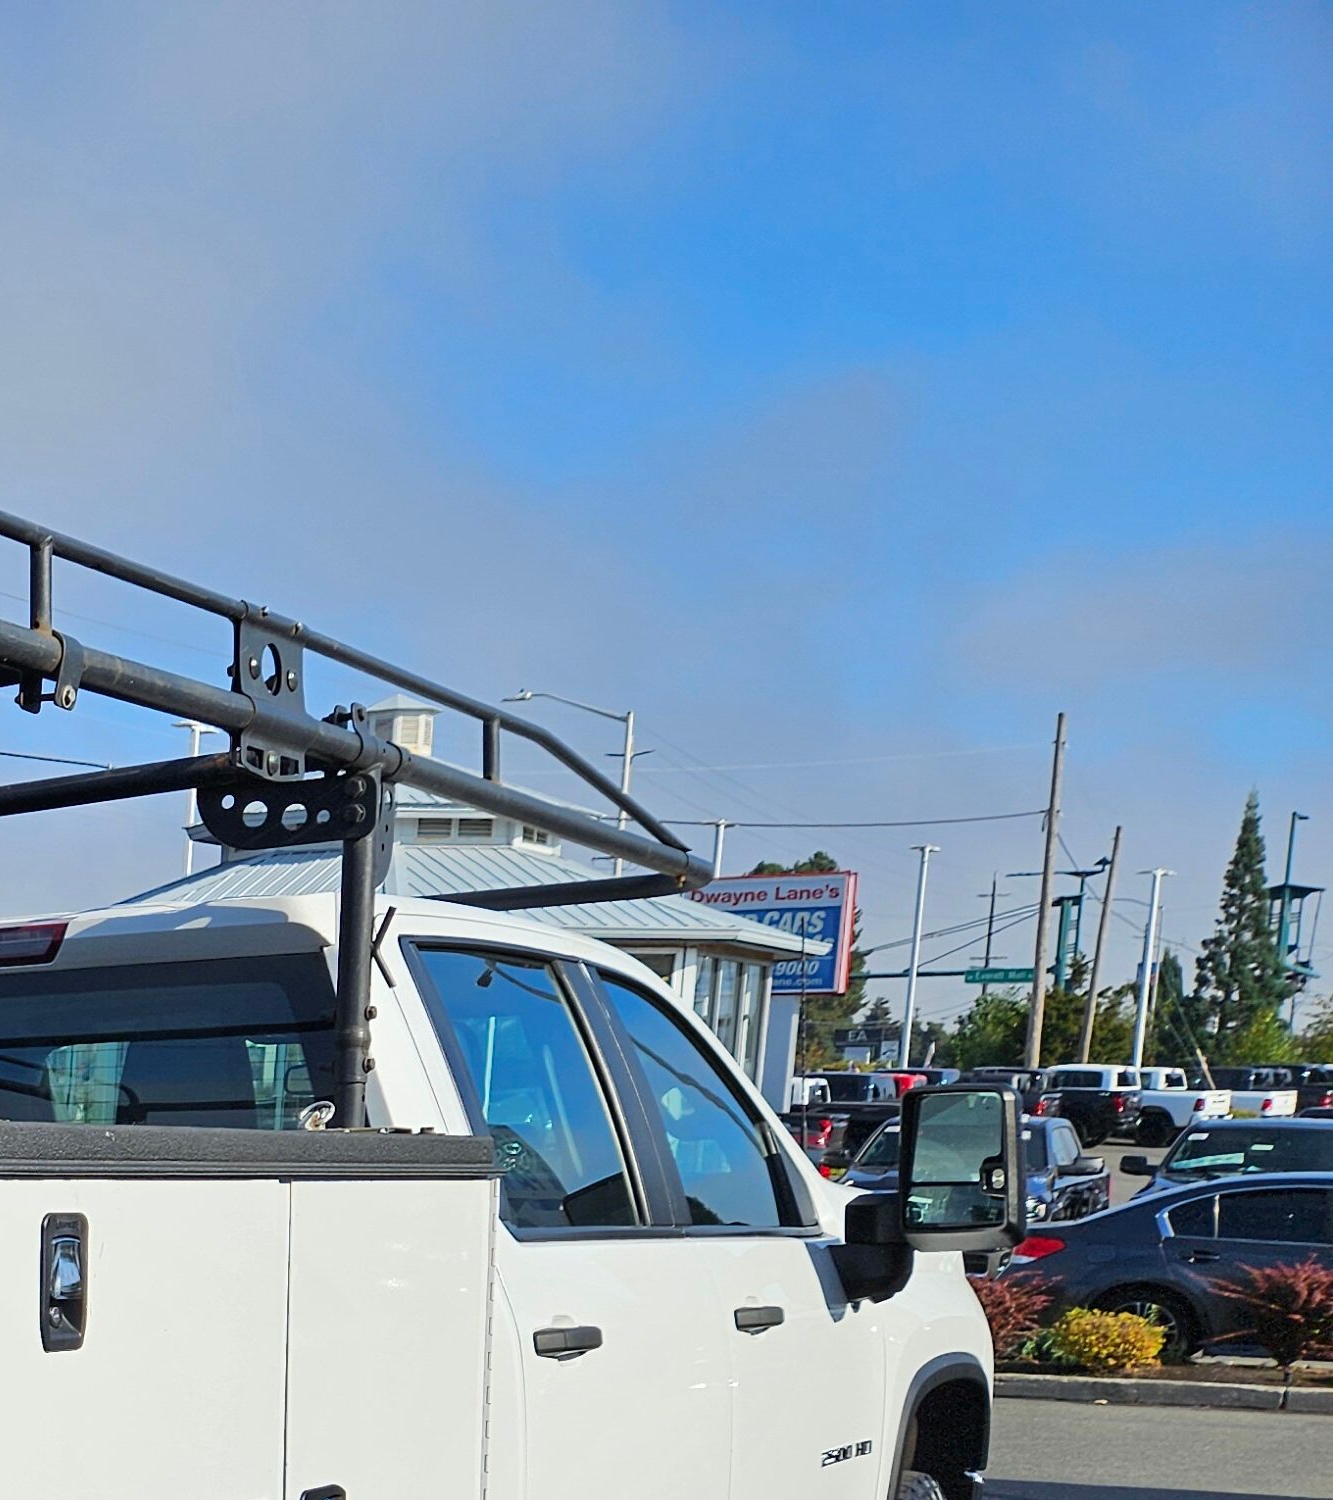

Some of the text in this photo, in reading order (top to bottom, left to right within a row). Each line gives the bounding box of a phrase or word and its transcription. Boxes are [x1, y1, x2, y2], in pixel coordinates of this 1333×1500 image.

[690, 884, 840, 906] Dwayne Lane's
[763, 911, 827, 934] CARS
[774, 960, 820, 977] 9000
[855, 1440, 872, 1457] HD
